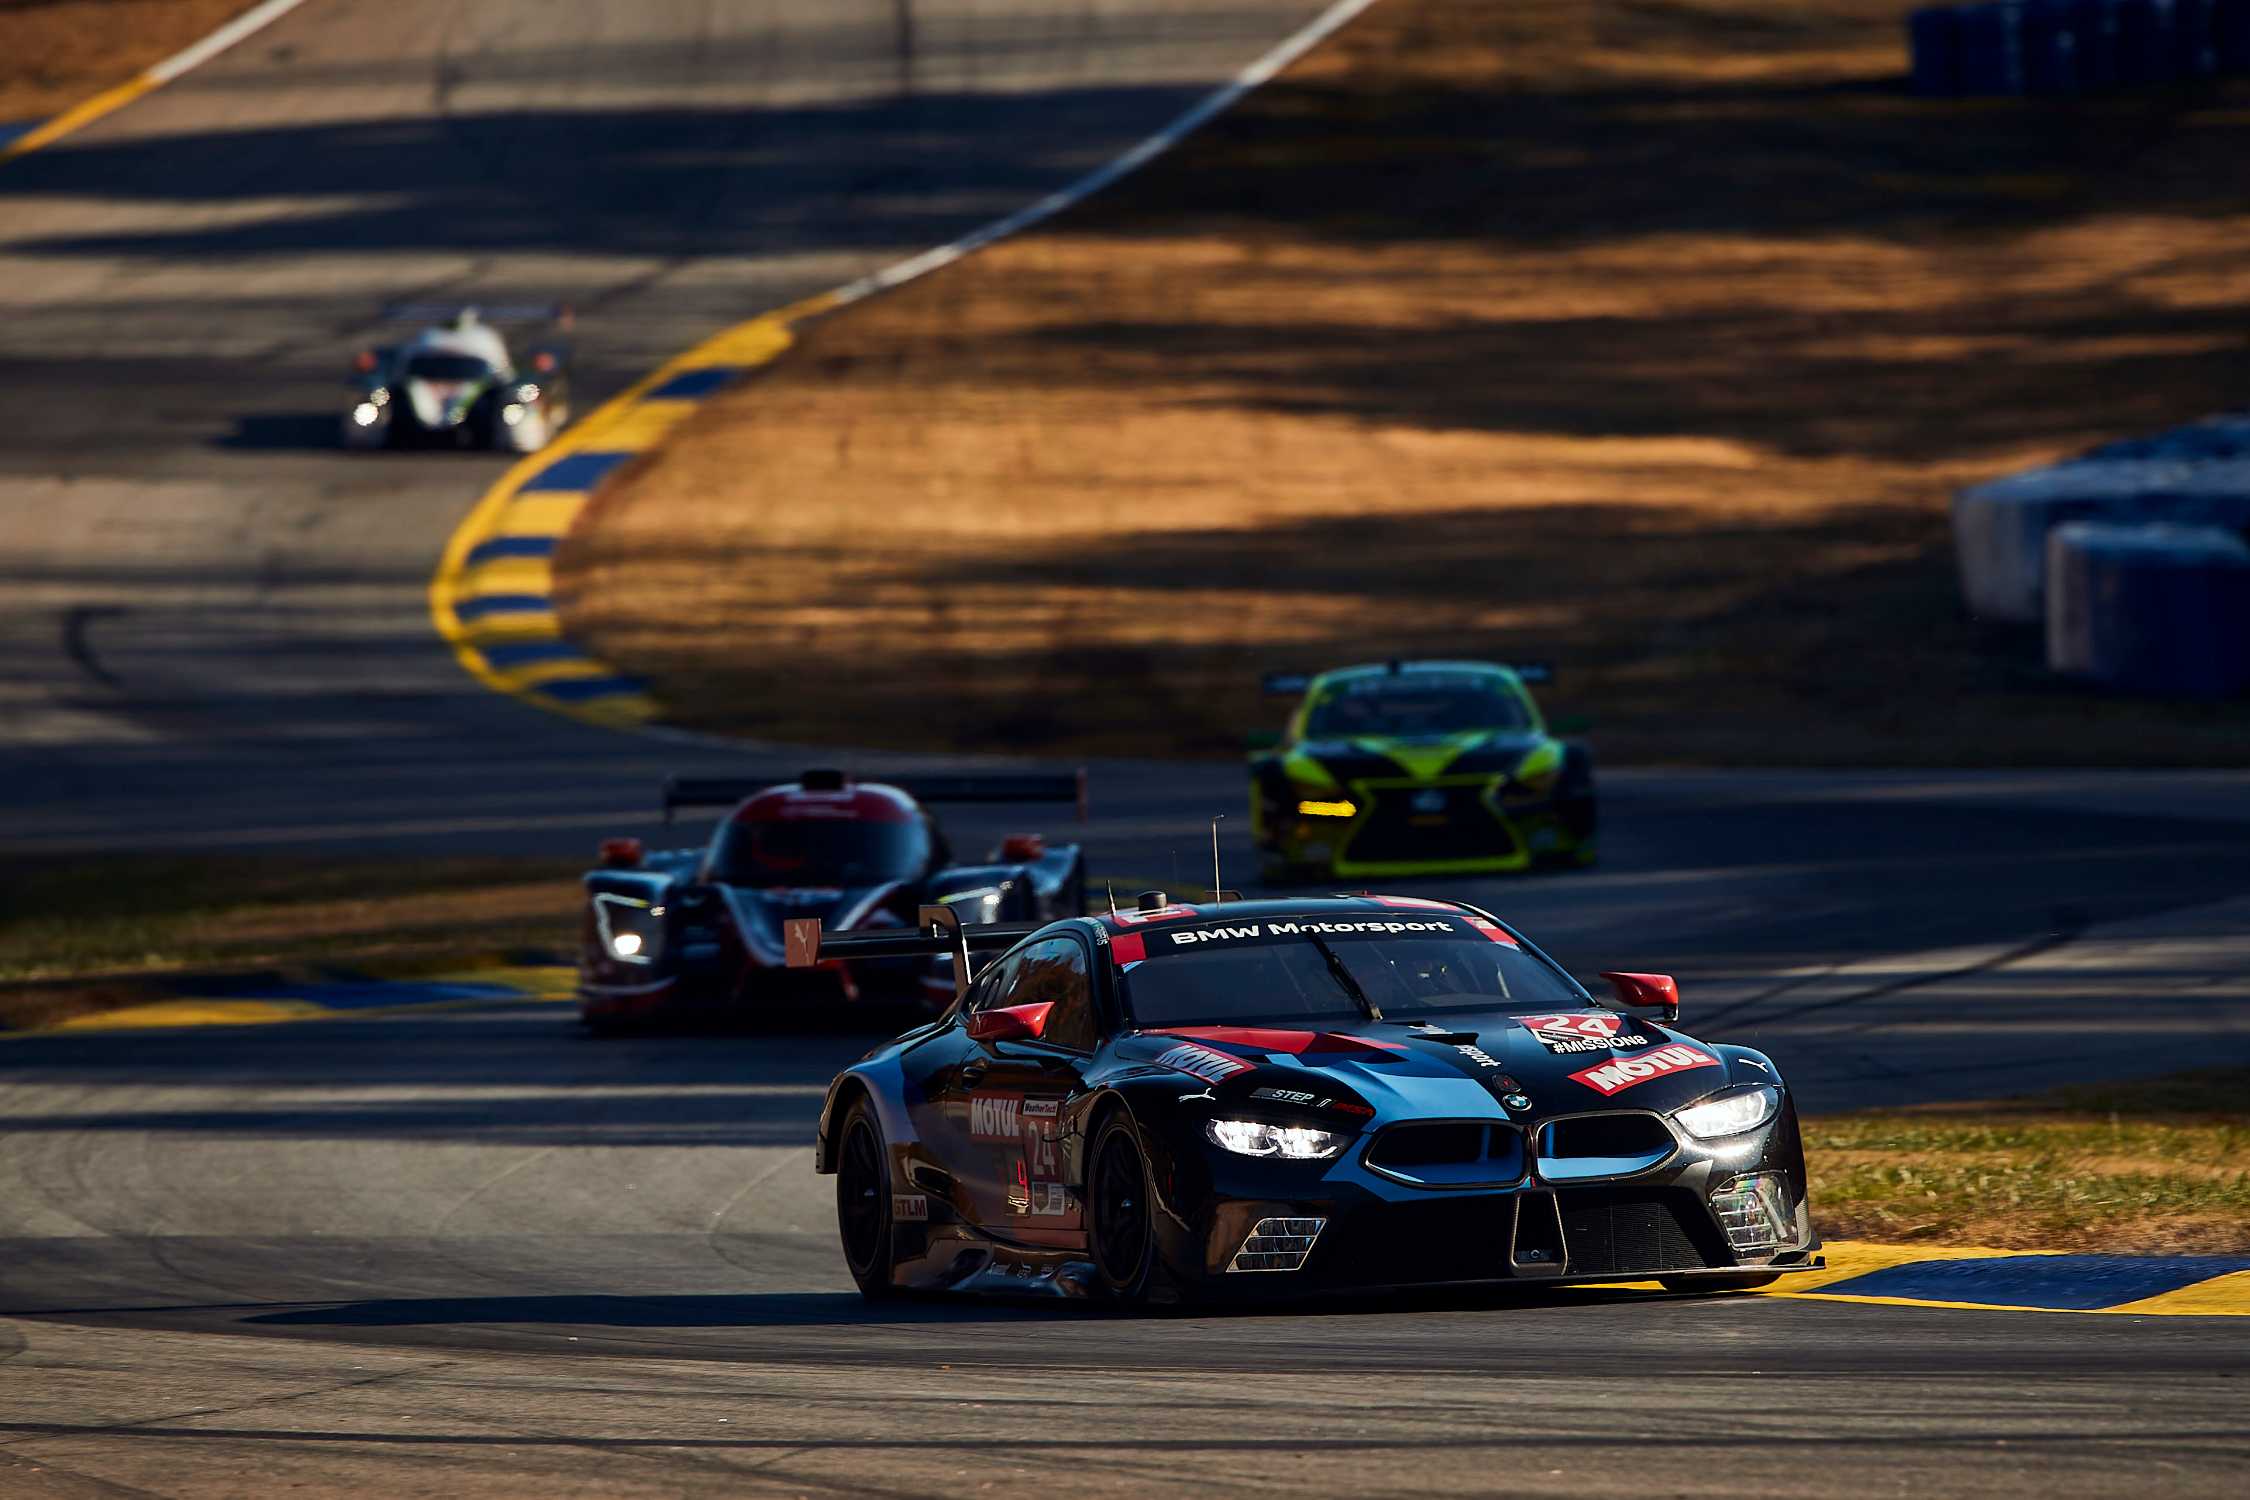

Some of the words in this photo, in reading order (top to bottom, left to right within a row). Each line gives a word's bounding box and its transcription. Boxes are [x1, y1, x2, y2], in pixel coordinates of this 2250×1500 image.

[1171, 925, 1259, 944] BMW
[1267, 921, 1454, 935] Motorsport
[1534, 1016, 1617, 1038] 24
[1553, 1035, 1648, 1054] #MISSION8
[1154, 1044, 1245, 1082] MOTUL
[1584, 1046, 1711, 1091] MOTUL
[1271, 1089, 1315, 1102] STEP
[971, 1097, 1019, 1137] MOTUL
[1028, 1120, 1056, 1176] 24
